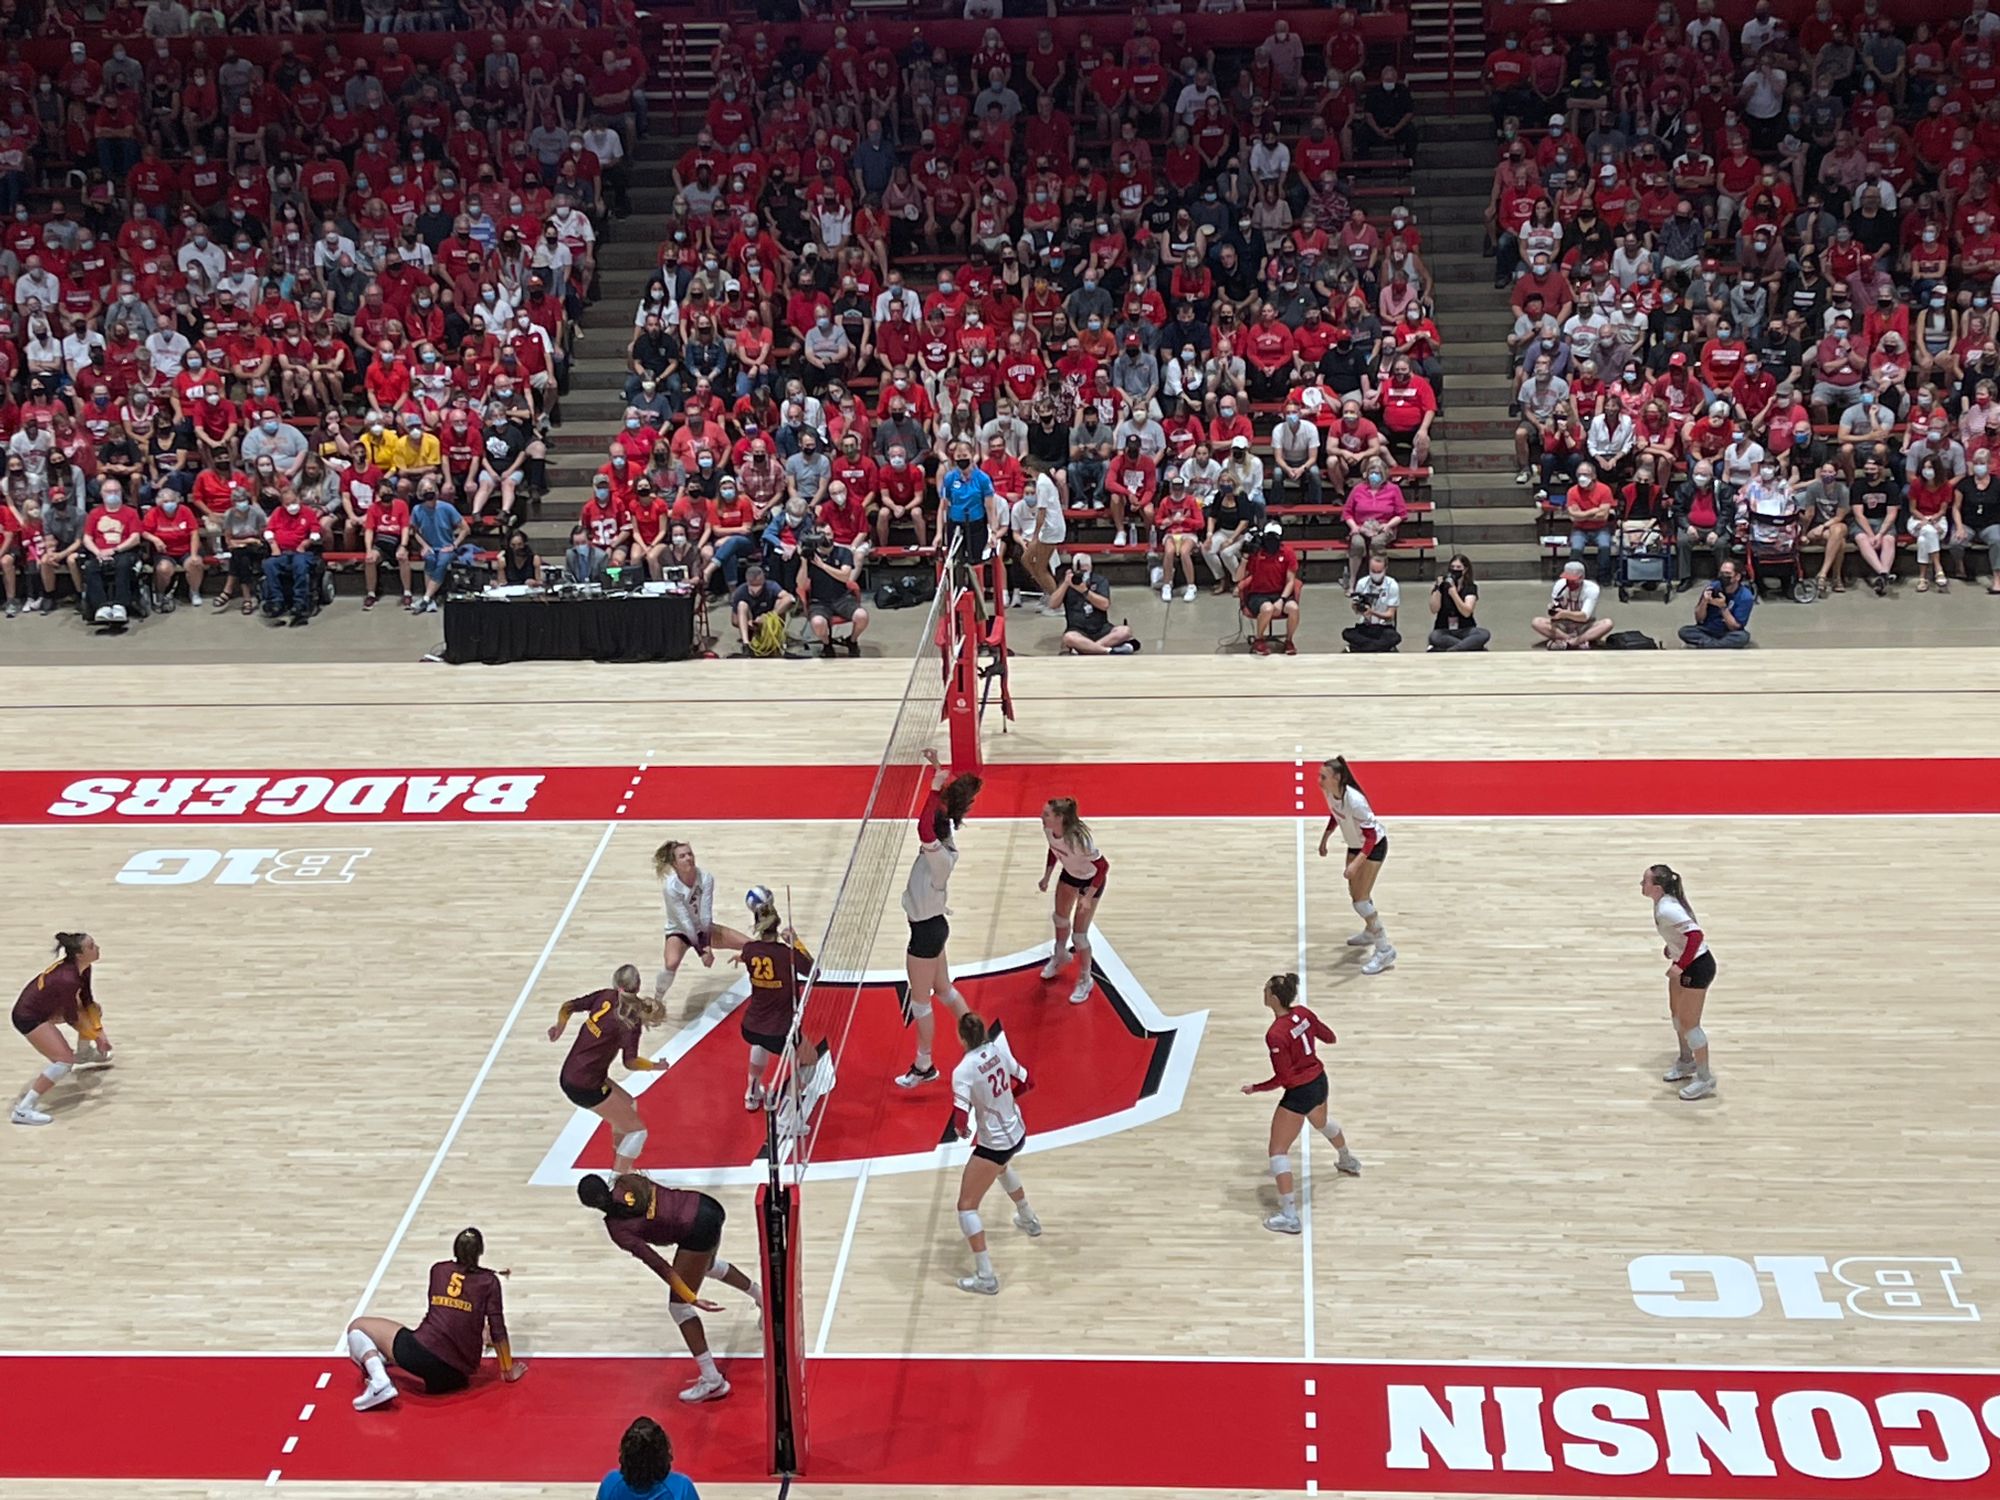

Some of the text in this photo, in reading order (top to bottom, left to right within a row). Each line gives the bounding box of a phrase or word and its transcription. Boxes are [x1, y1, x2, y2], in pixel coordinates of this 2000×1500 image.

[47, 775, 546, 816] BADGERS
[751, 956, 774, 980] 23
[987, 1067, 1009, 1098] 22
[446, 1271, 466, 1298] 5
[1386, 1384, 2000, 1481] CONSIN
